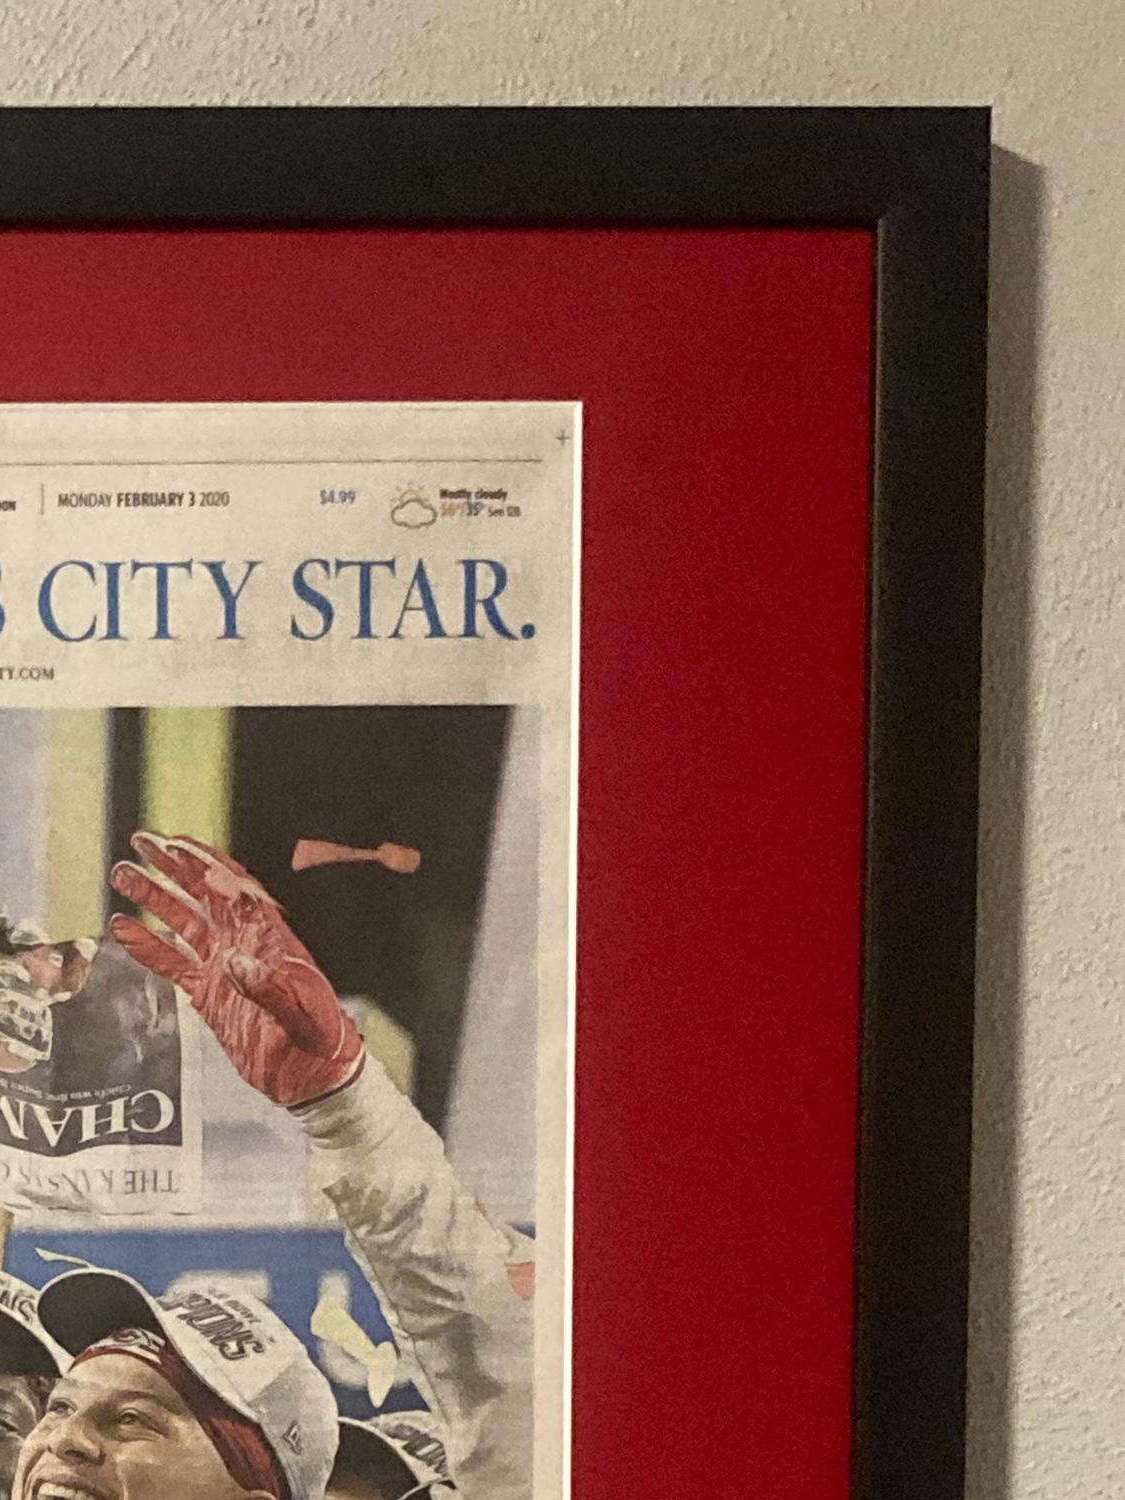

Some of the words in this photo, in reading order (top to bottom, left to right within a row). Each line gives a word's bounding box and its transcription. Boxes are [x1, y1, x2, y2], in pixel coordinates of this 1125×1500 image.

[58, 493, 113, 508] MONDAY
[116, 492, 185, 507] FEBRUARY
[188, 492, 196, 507] 3
[199, 491, 230, 507] 2020
[320, 489, 356, 504] $4.99
[475, 487, 508, 501] cloudy
[37, 558, 263, 643] CITY
[289, 556, 537, 643] STAR.
